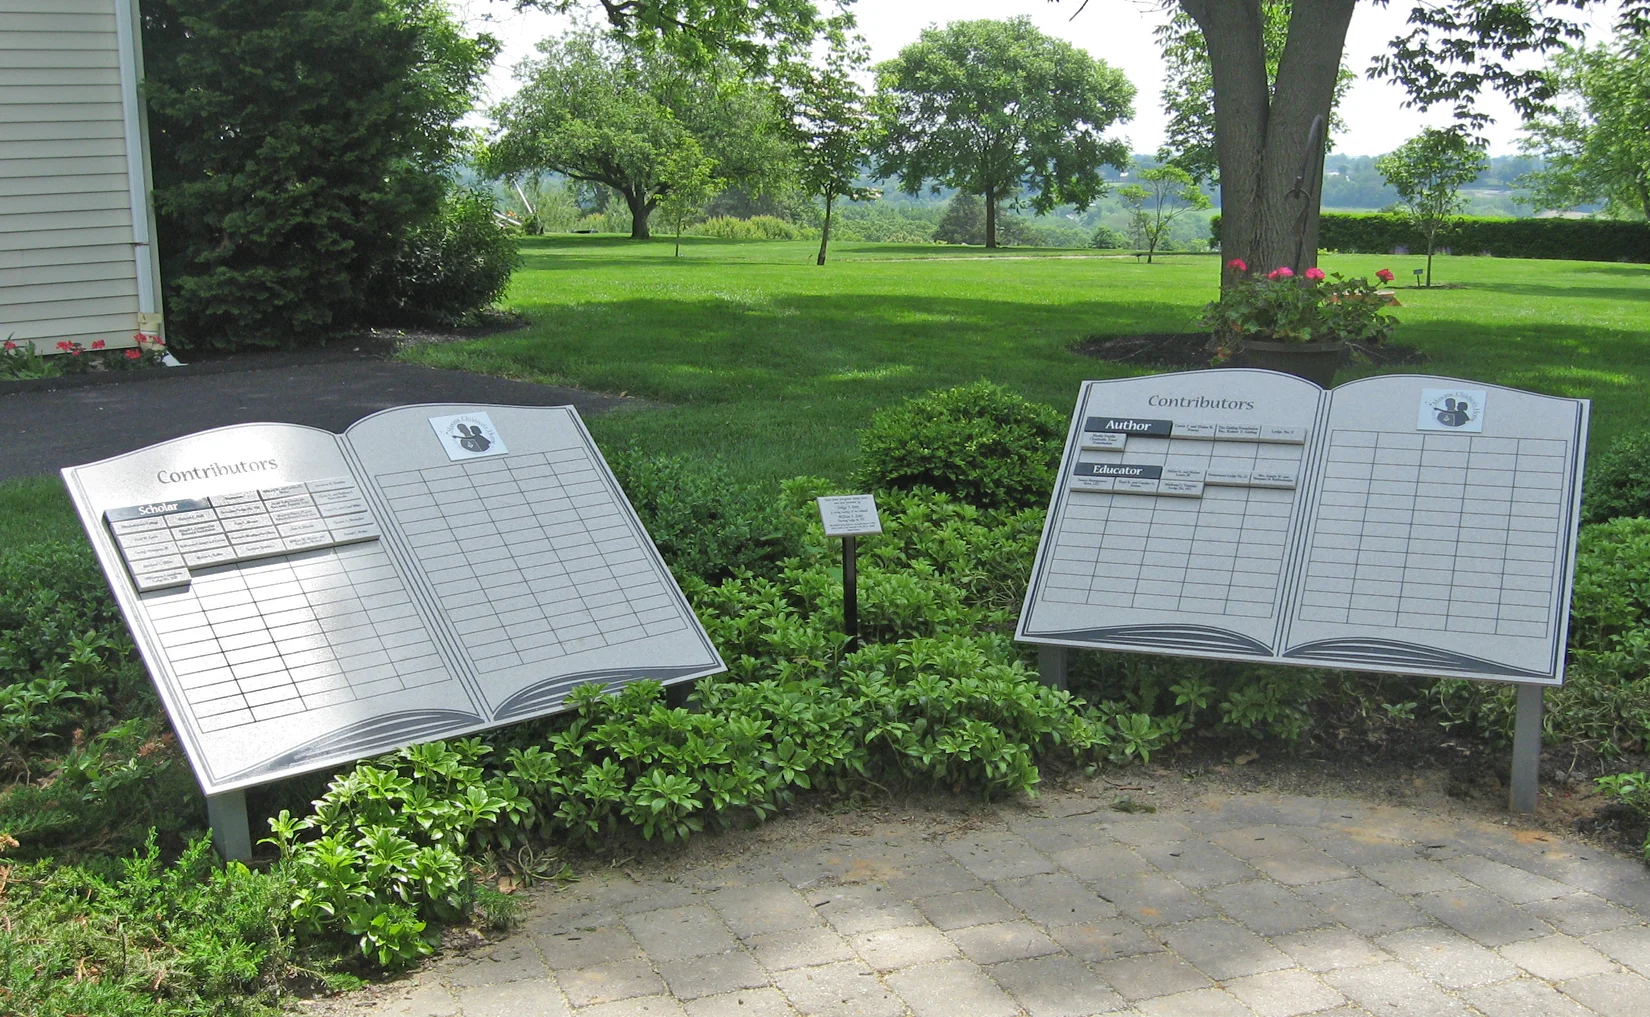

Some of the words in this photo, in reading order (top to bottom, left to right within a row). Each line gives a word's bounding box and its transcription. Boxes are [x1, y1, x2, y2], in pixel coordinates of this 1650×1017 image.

[1148, 394, 1255, 411] Contributors
[1105, 419, 1152, 431] Author
[156, 457, 280, 484] Contributors
[1093, 464, 1143, 477] Educator
[138, 501, 178, 515] Scholar
